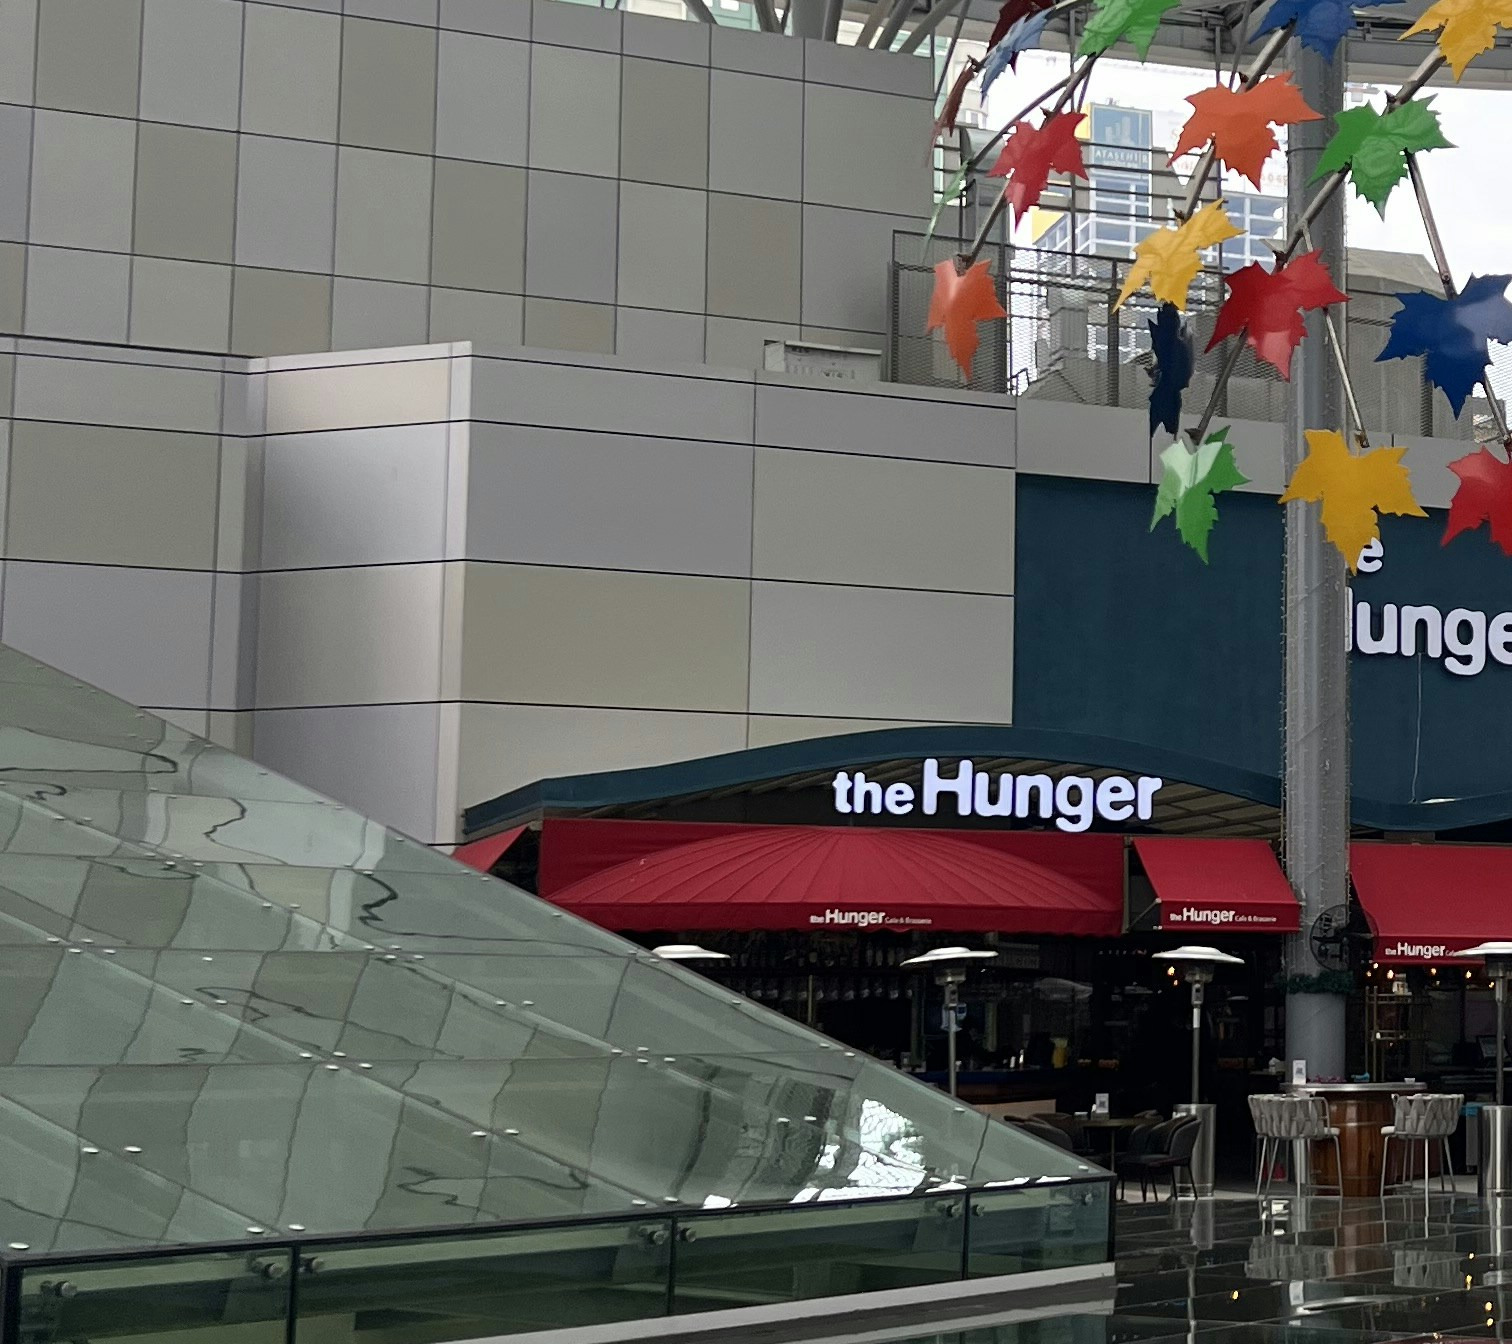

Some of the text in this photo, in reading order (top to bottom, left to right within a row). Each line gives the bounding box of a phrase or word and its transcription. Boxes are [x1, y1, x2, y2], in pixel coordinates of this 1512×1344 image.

[832, 759, 1162, 831] the Hunger
[825, 909, 886, 926] Hunger
[1182, 907, 1236, 925] Hunger
[1397, 942, 1445, 958] Hunger
